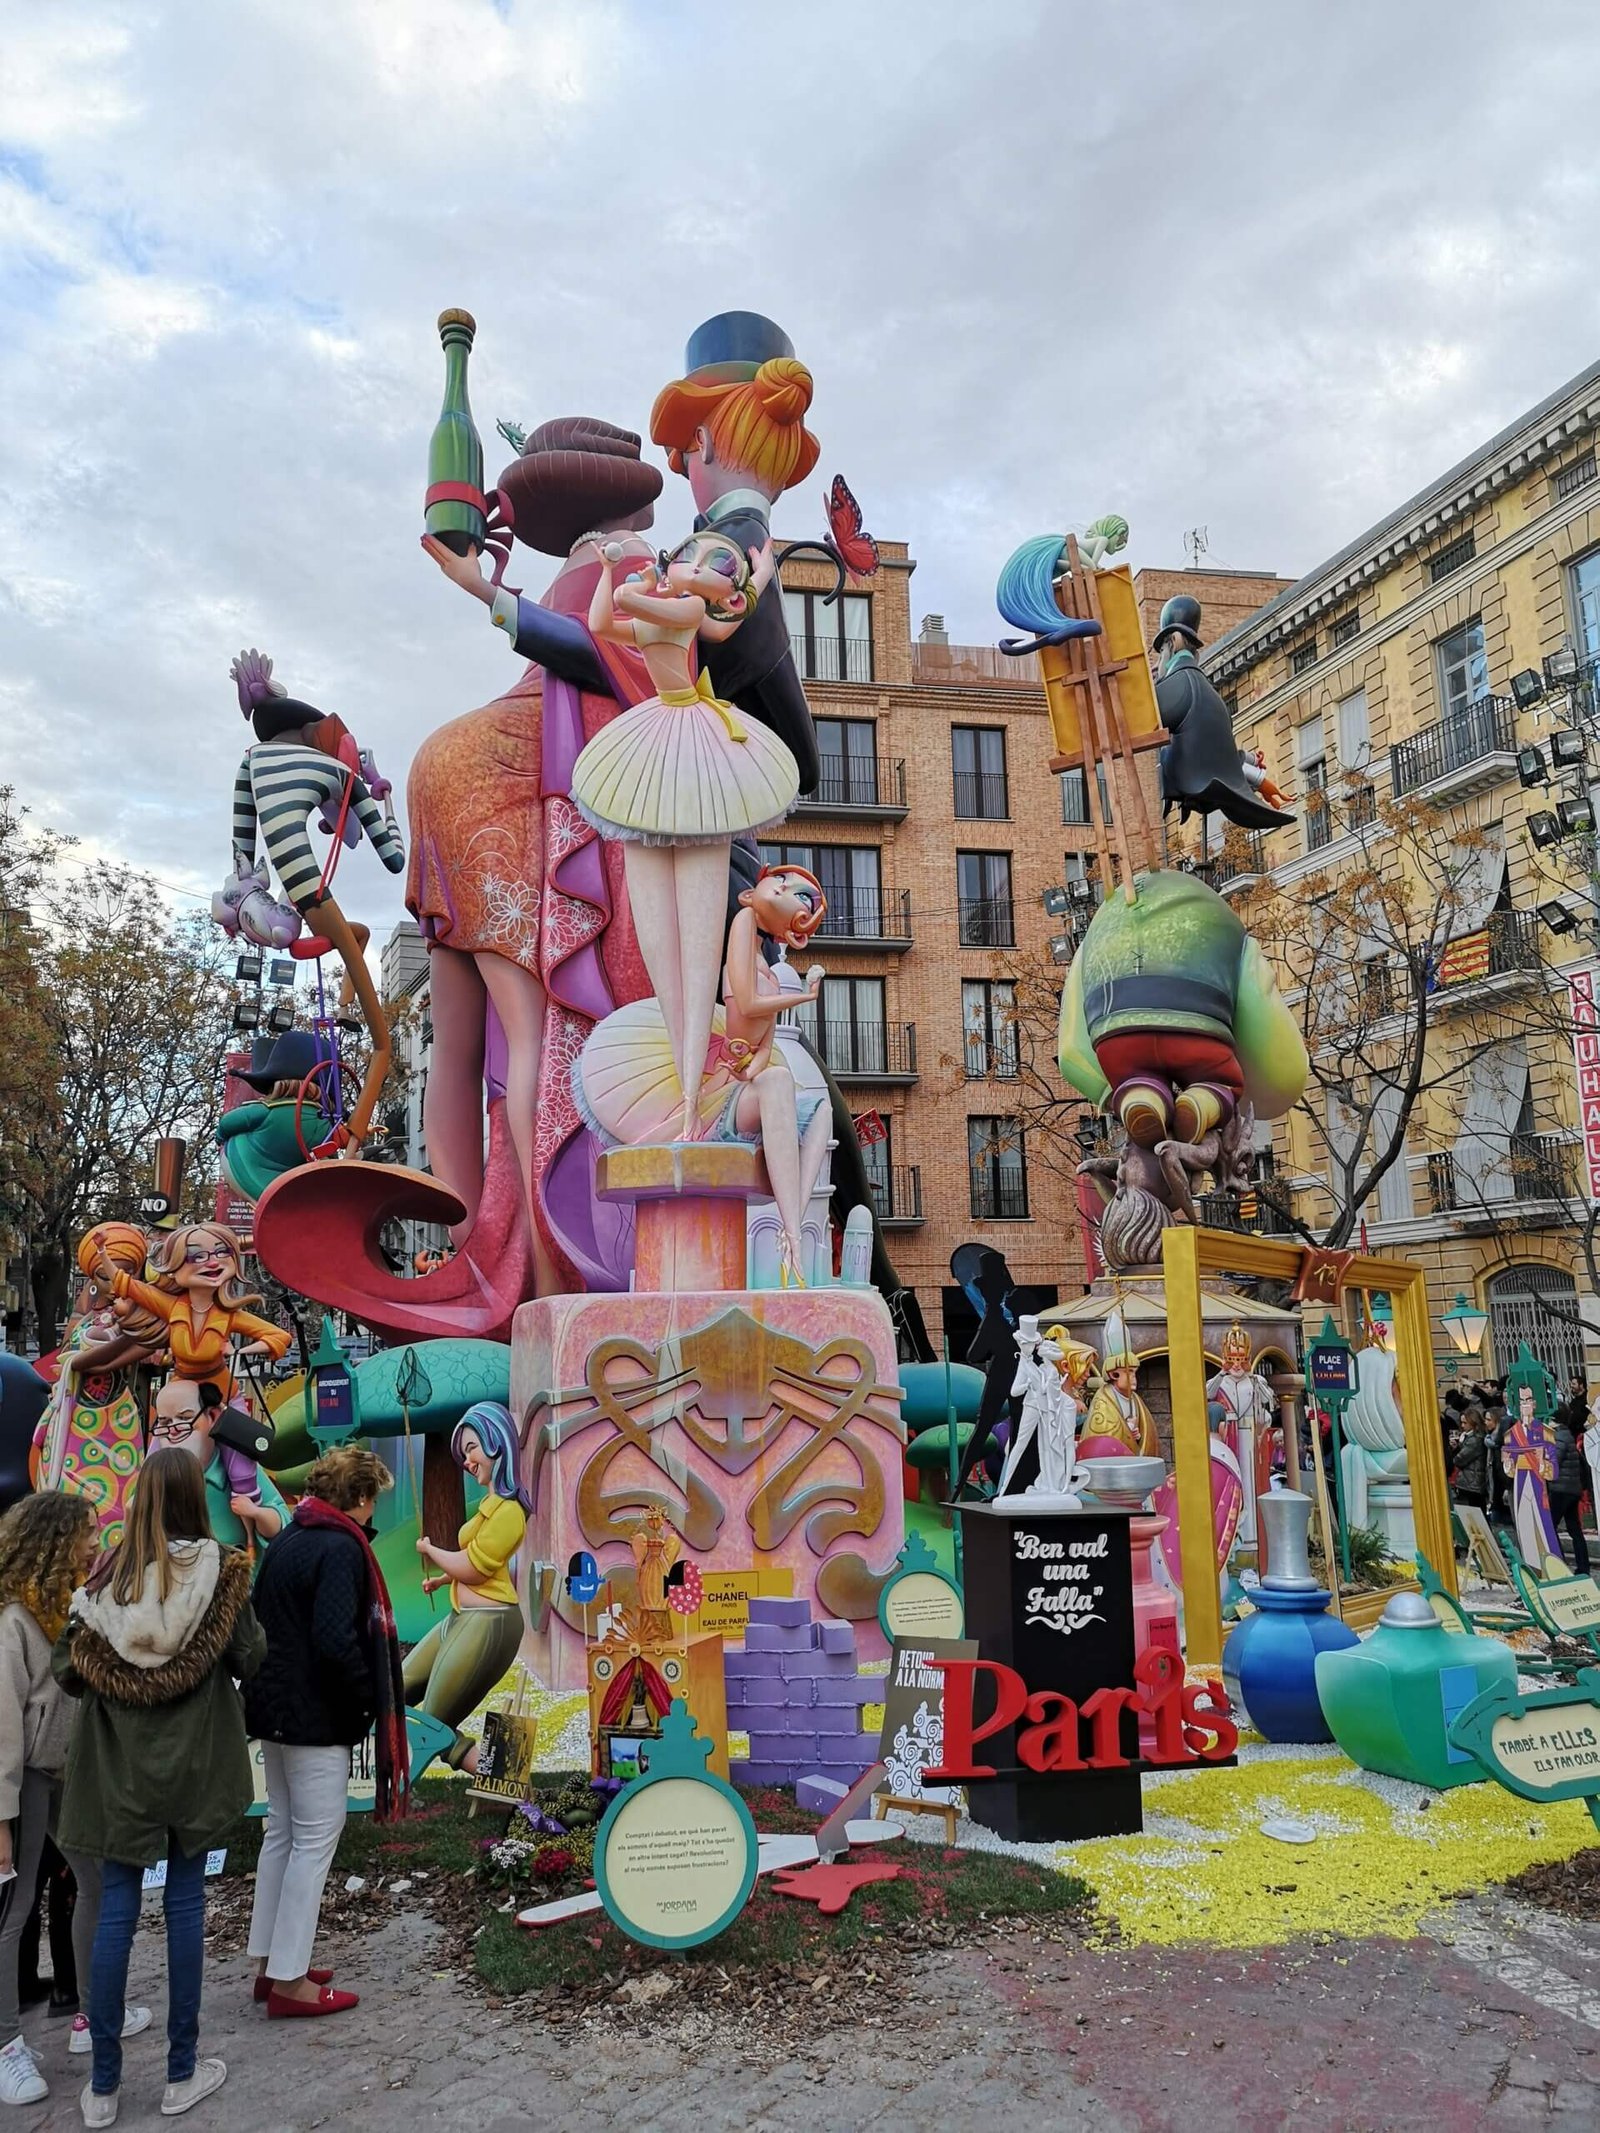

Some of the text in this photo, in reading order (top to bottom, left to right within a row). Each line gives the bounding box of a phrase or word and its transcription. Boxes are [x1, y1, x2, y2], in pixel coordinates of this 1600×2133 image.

[140, 1198, 167, 1212] NO
[1319, 1355, 1341, 1364] PLACE
[1068, 1533, 1109, 1558] val
[1042, 1564, 1090, 1580] una
[708, 1591, 749, 1602] CHANEL
[1025, 1586, 1104, 1612] Falla"
[703, 1619, 716, 1627] EAU
[718, 1618, 728, 1626] DE
[904, 1669, 916, 1688] LA
[1540, 1735, 1549, 1749] A
[1549, 1727, 1597, 1751] ELLES
[1533, 1759, 1554, 1772] ELS
[473, 1774, 528, 1798] RAIMON
